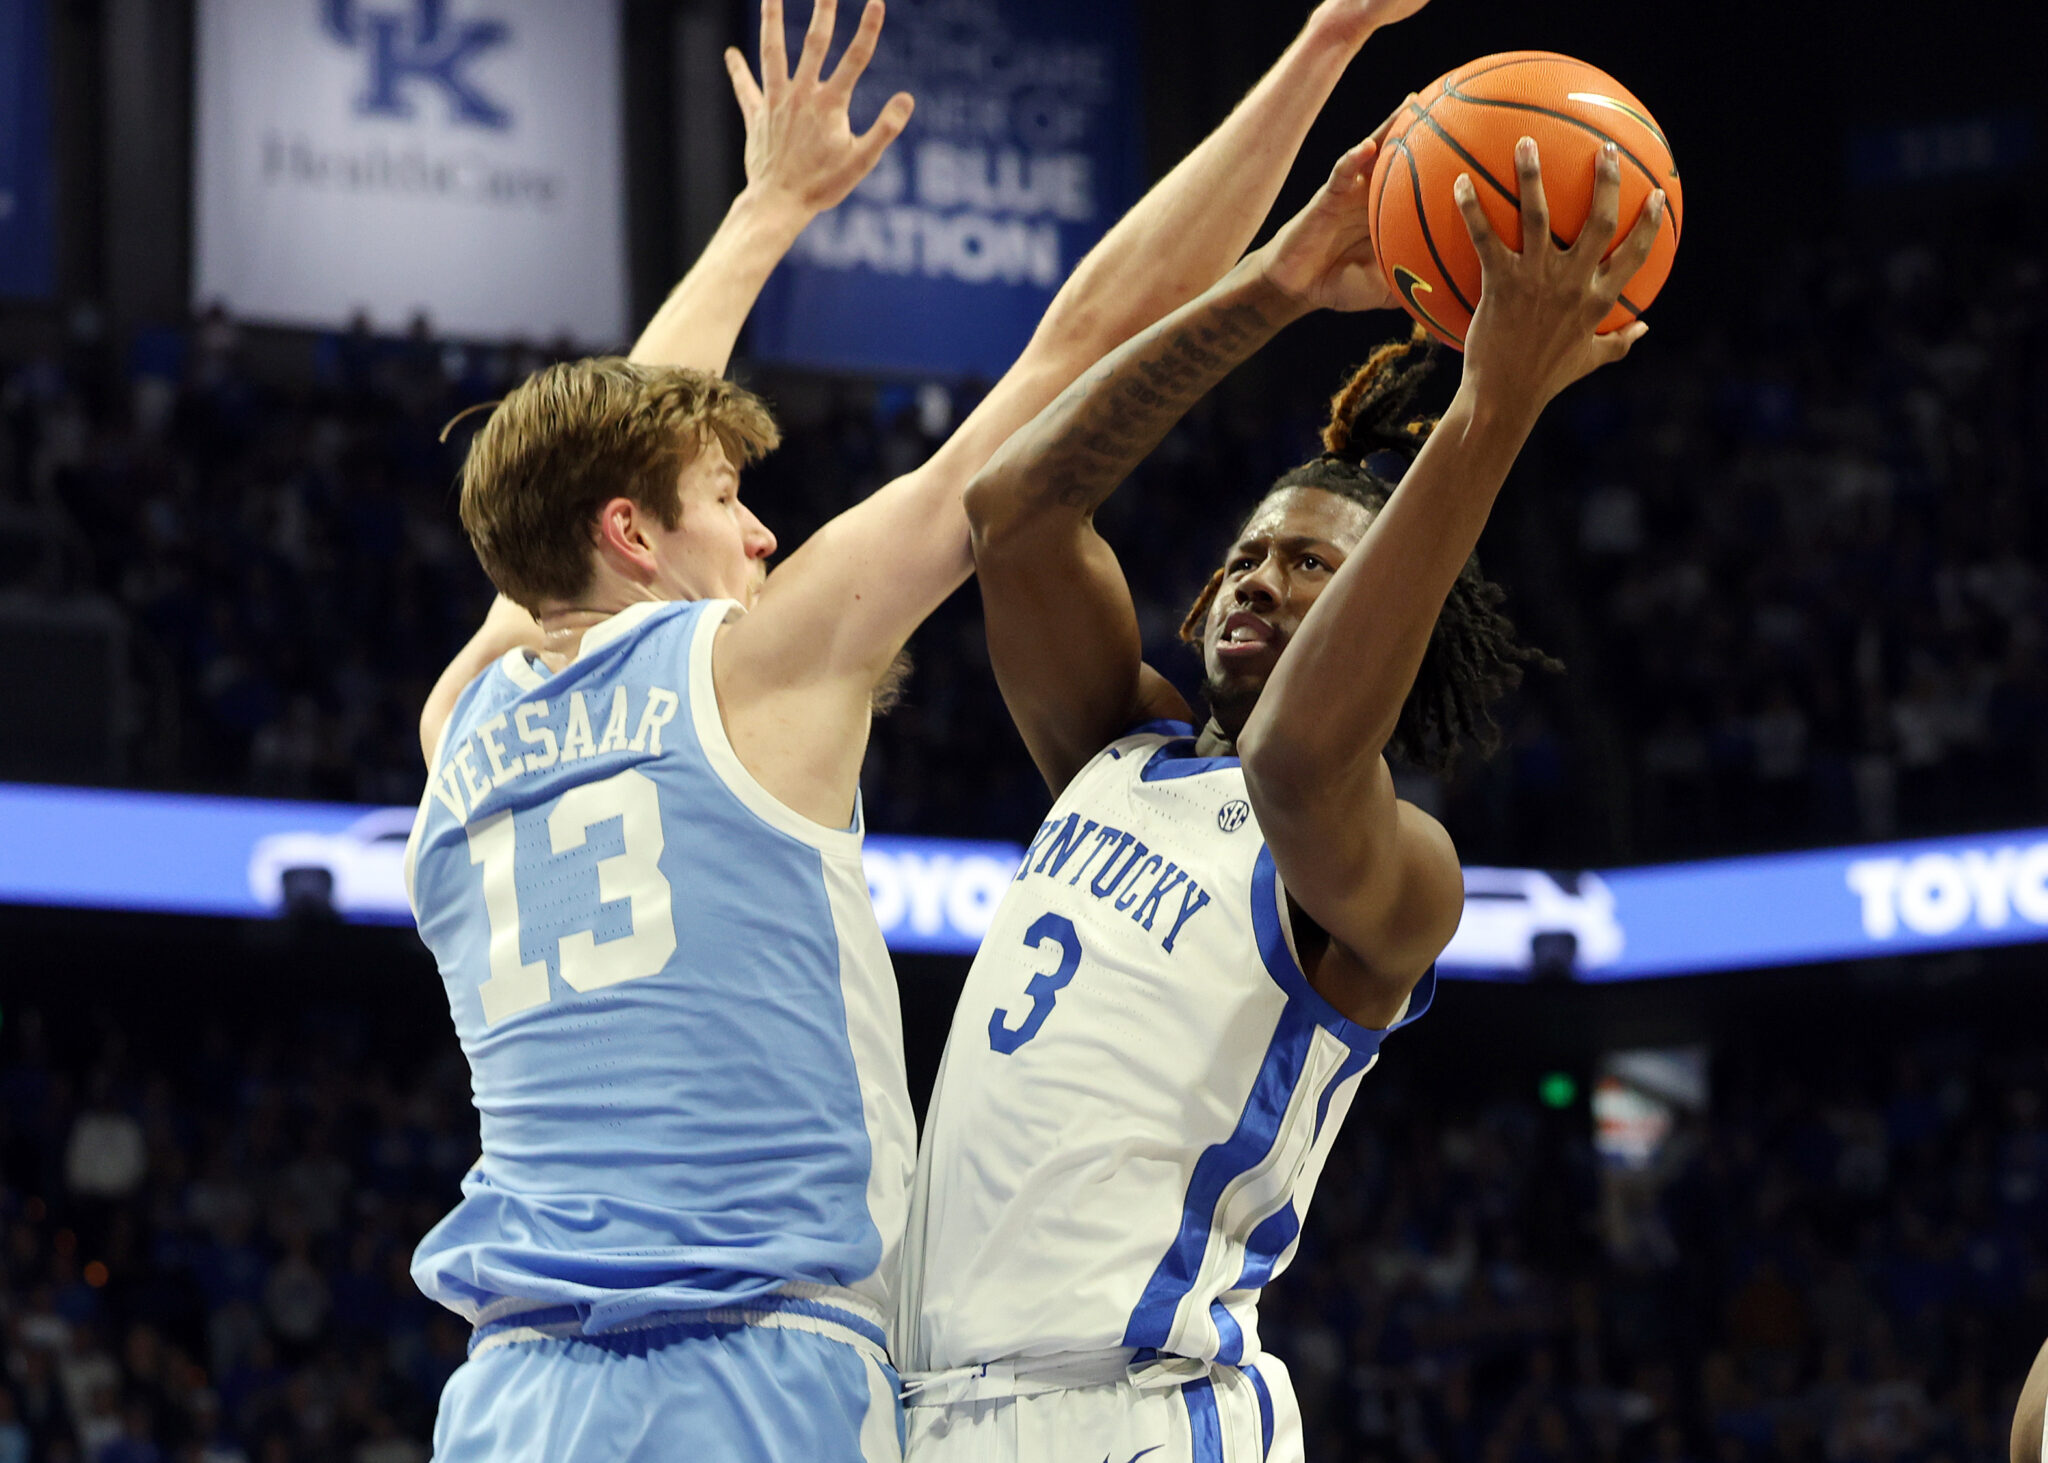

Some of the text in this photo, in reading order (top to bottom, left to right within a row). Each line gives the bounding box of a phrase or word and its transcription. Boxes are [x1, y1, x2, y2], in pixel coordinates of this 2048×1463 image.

[916, 142, 1094, 224] BLUE
[430, 686, 680, 827] VEESAAR
[1219, 800, 1249, 832] SEC
[464, 767, 677, 1026] 13
[988, 912, 1082, 1055] 3
